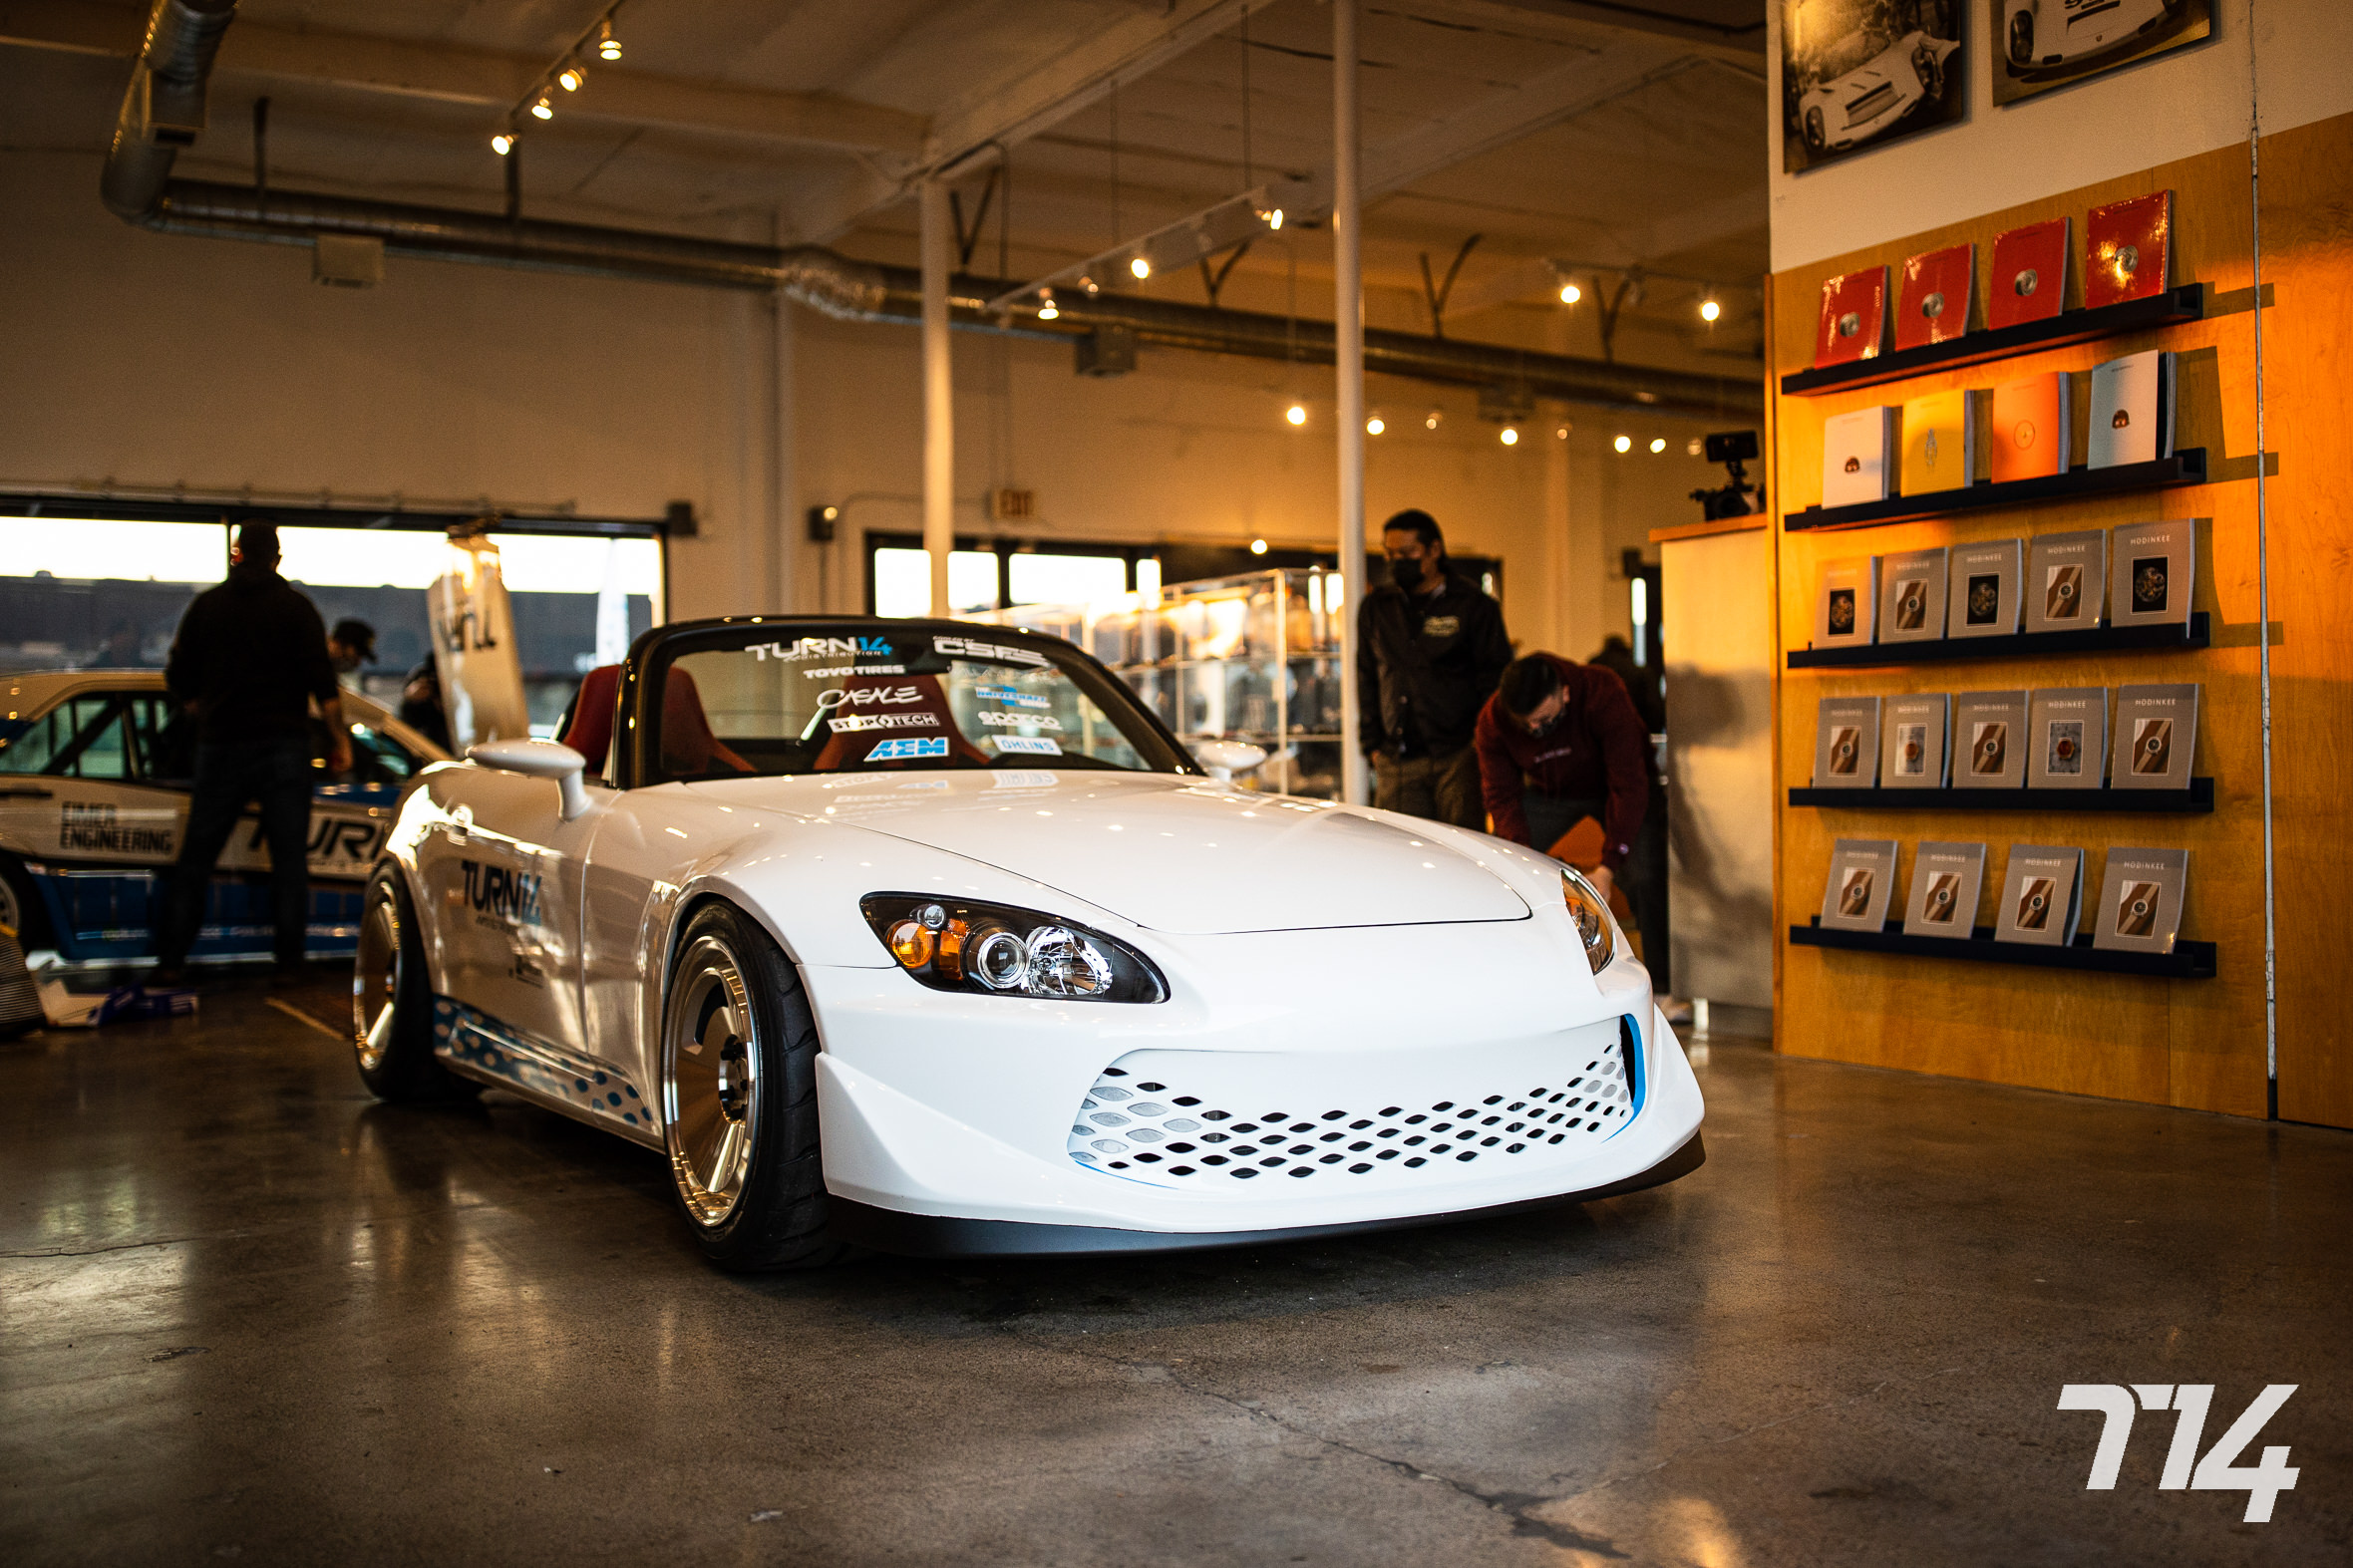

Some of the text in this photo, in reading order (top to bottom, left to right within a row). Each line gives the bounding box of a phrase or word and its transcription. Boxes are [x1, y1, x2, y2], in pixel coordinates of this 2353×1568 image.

[2130, 534, 2172, 545] HODINKEE
[2046, 544, 2086, 555] HODINKEE
[803, 665, 905, 680] TOYO TIRES
[2048, 700, 2087, 710] HODINKEE
[2135, 698, 2177, 708] HODINKEE
[978, 711, 1063, 732] sparco
[863, 737, 949, 763] AEM
[61, 826, 173, 854] ENGINEERING
[2024, 858, 2063, 867] HODINKEE
[2123, 861, 2166, 870] HODINKEE
